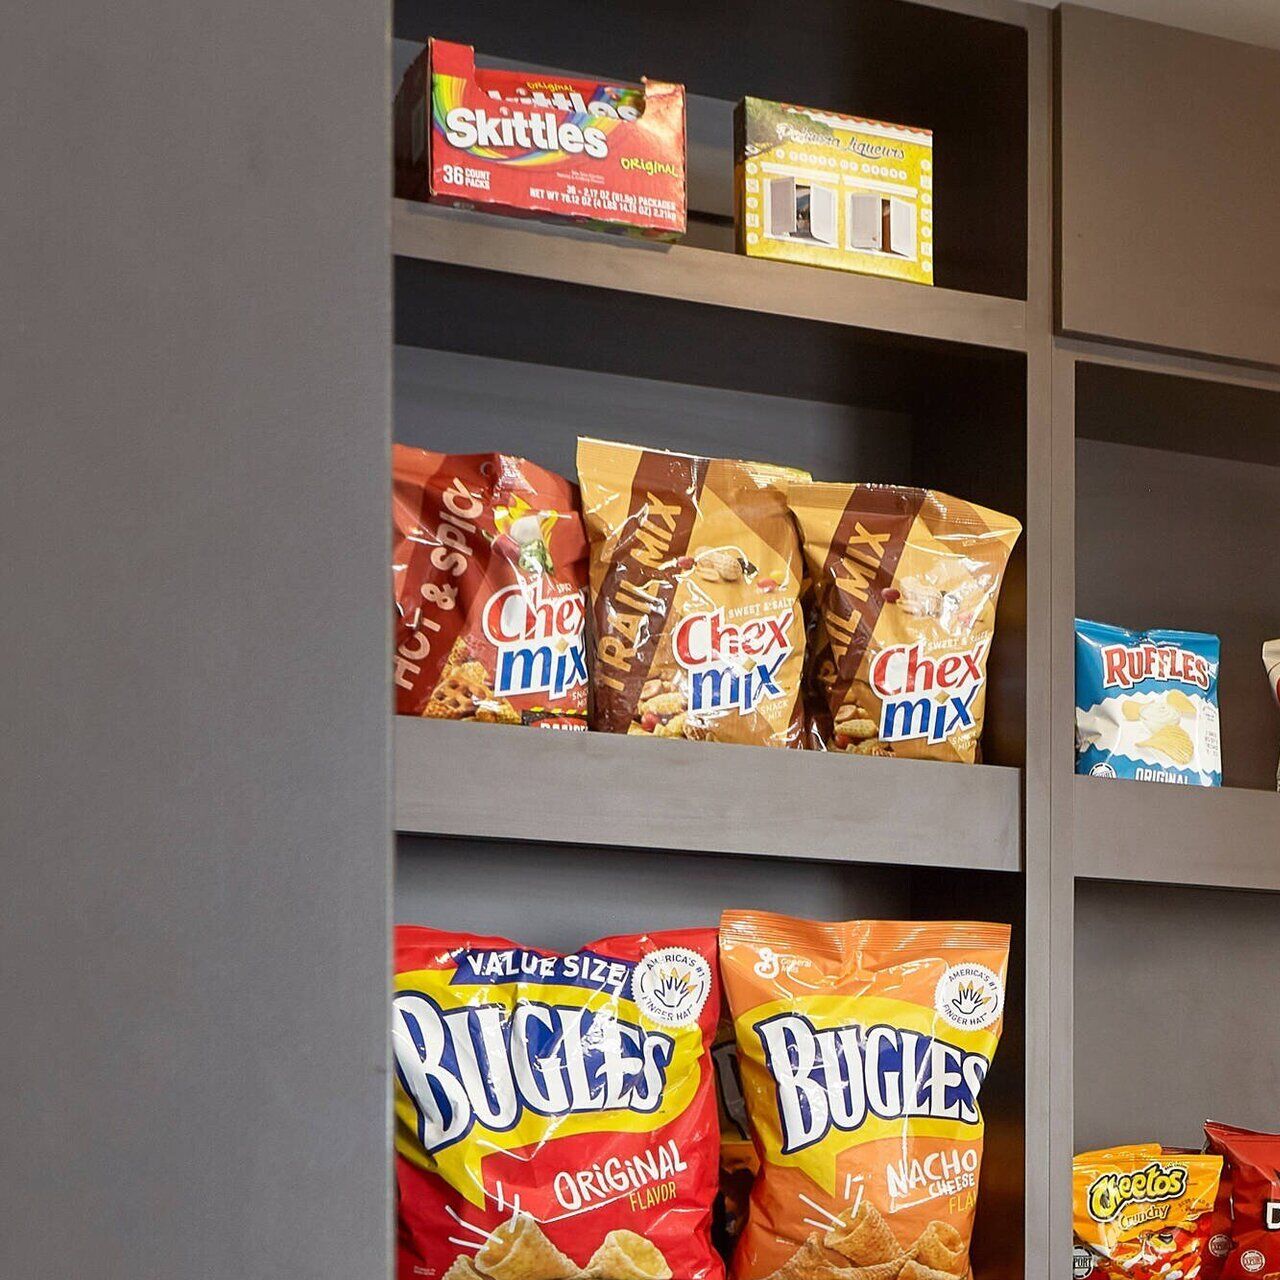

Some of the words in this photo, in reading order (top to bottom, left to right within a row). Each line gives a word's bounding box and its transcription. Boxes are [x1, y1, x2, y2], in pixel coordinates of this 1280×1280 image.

[445, 105, 609, 159] Skittles
[443, 164, 464, 186] 36
[465, 169, 491, 181] COUNT
[465, 178, 491, 190] PACKS
[529, 187, 545, 199] NET
[547, 190, 559, 201] WT
[629, 491, 682, 569] MIX
[834, 521, 891, 603] MIX
[420, 582, 459, 612] &
[727, 601, 762, 618] SWEET
[675, 611, 794, 666] Chex
[500, 640, 588, 695] mix
[691, 652, 787, 711] mix
[873, 643, 984, 697] Chex
[1102, 644, 1210, 690] RUFFLES
[882, 684, 978, 741] mix
[465, 953, 558, 985] VALUE
[562, 953, 629, 987] SIZE
[948, 968, 990, 984] AMERICA'S
[943, 1003, 968, 1025] FINGER
[969, 1012, 987, 1026] HAT
[392, 993, 672, 1152] BUGLES
[755, 1014, 990, 1153] BUGLES
[887, 1148, 979, 1198] NACHO
[928, 1174, 977, 1199] CHEESE
[1089, 1166, 1185, 1216] Cheetos
[629, 1183, 678, 1212] FLAVOR
[1119, 1204, 1169, 1230] Crunchy
